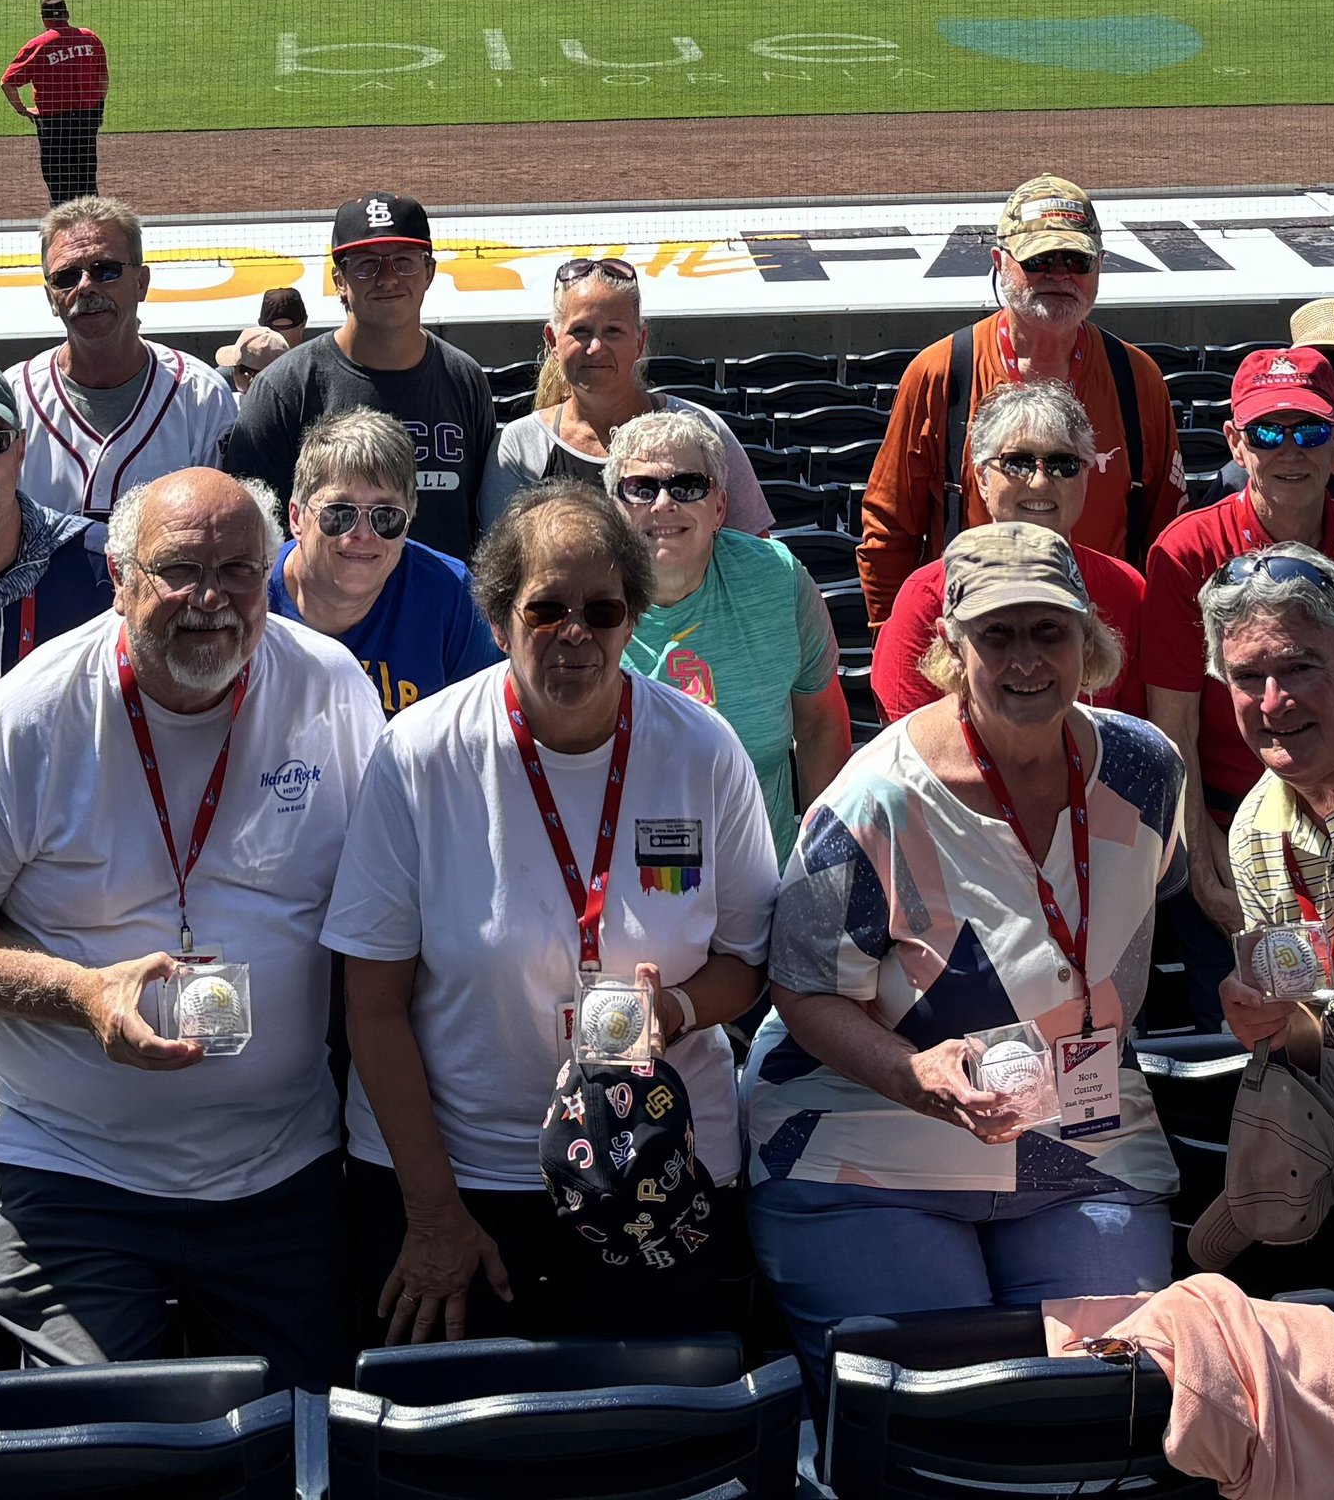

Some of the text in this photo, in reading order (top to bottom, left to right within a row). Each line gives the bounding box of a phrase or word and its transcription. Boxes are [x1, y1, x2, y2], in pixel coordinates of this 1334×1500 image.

[46, 43, 94, 67] ELITE
[275, 27, 900, 76] blue
[260, 764, 322, 788] Hard Rock
[1078, 1072, 1099, 1083] Nora
